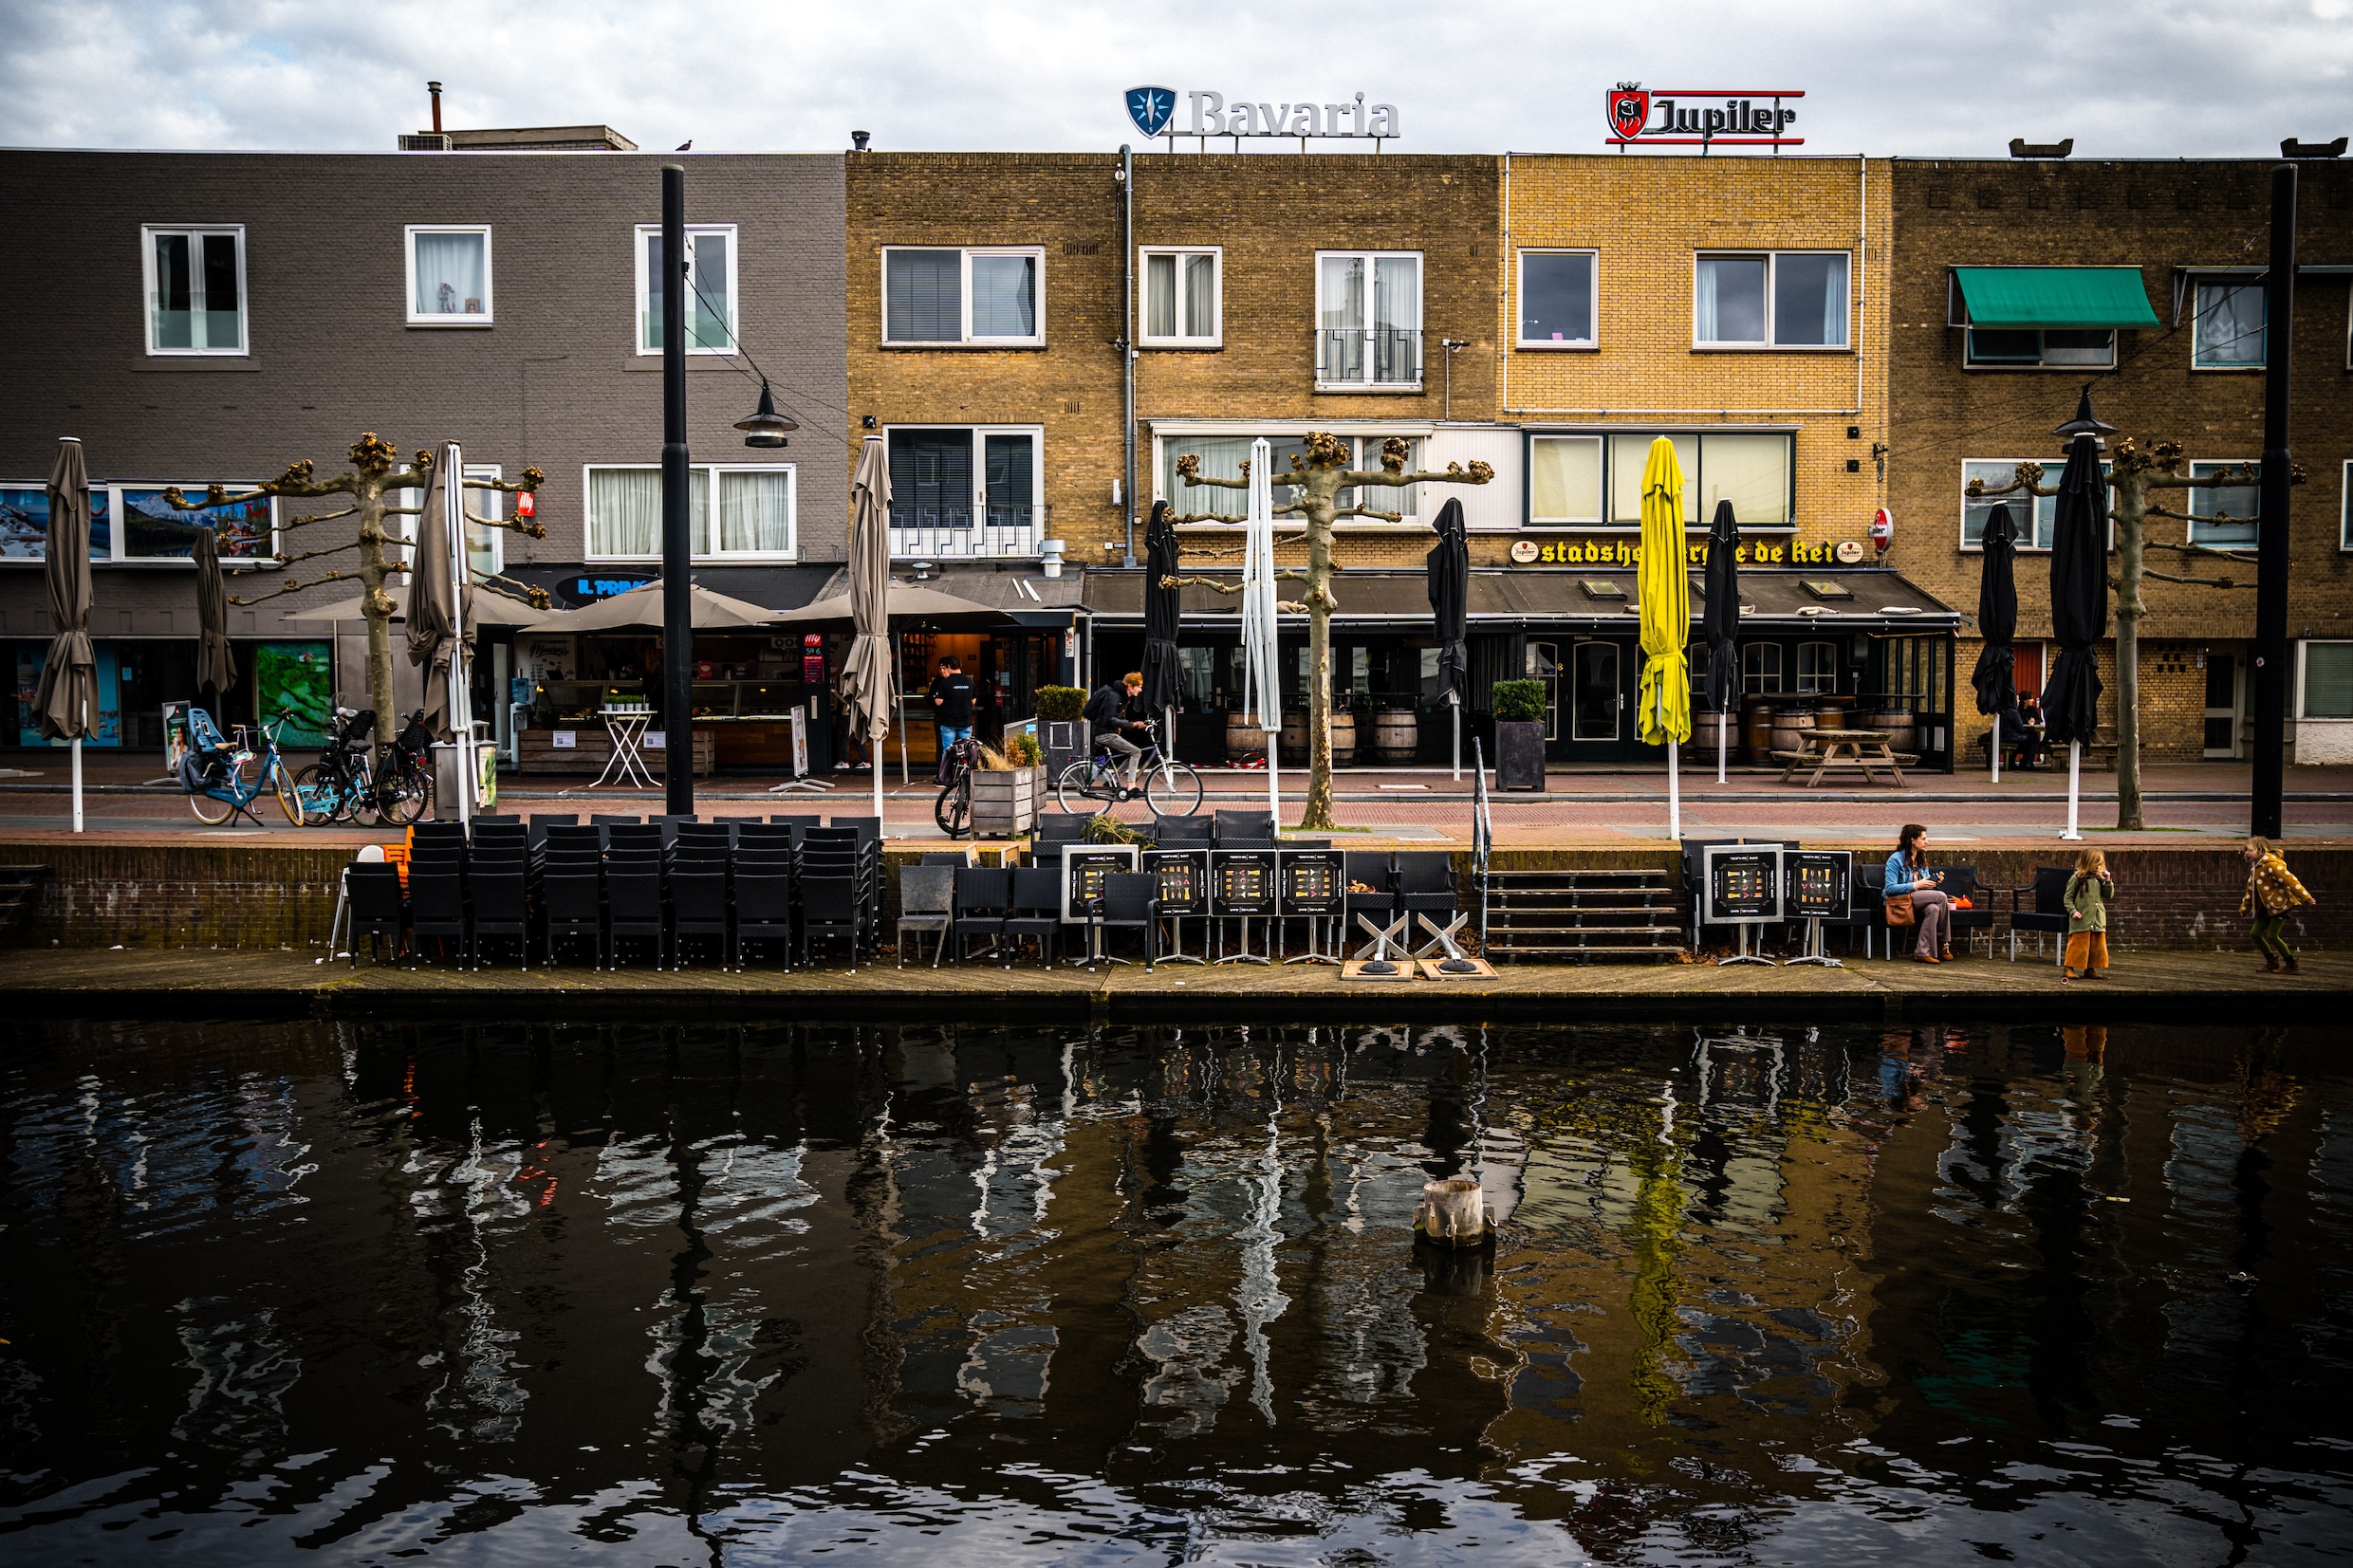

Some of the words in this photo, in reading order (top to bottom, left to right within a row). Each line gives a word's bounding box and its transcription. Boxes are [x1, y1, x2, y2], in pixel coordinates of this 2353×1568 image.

[1189, 91, 1400, 137] Bavaria
[1654, 100, 1796, 141] Jupiler
[519, 491, 533, 513] illy
[1754, 540, 1783, 563] de
[578, 579, 594, 595] IL
[806, 634, 821, 645] illy
